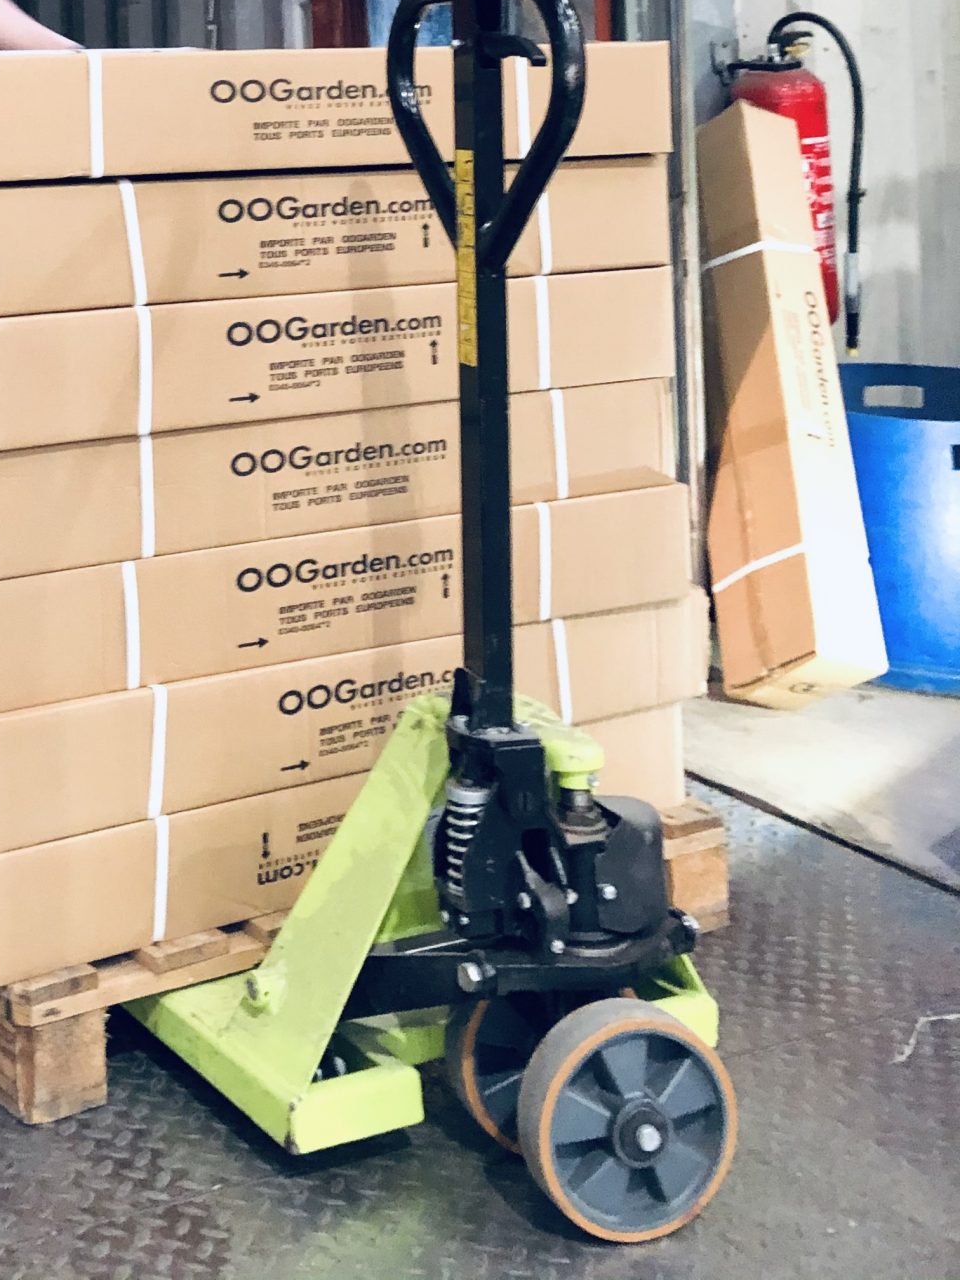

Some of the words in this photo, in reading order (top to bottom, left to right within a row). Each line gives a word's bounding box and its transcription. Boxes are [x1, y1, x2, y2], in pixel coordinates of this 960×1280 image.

[211, 78, 432, 103] OOGarden.m
[309, 119, 329, 128] PAR
[219, 196, 435, 223] OOGarden.com
[313, 236, 334, 245] PAR
[227, 315, 443, 346] OOGarden.com
[323, 356, 344, 366] PAR
[804, 291, 835, 448] OOGardencom
[231, 438, 448, 477] OOGarden.com
[327, 483, 348, 494] PAR
[237, 548, 454, 593] OOGarden.com
[333, 595, 354, 606] PAR
[279, 669, 454, 715] OOGarden.c
[371, 714, 392, 726] PAR
[258, 859, 318, 885] .com
